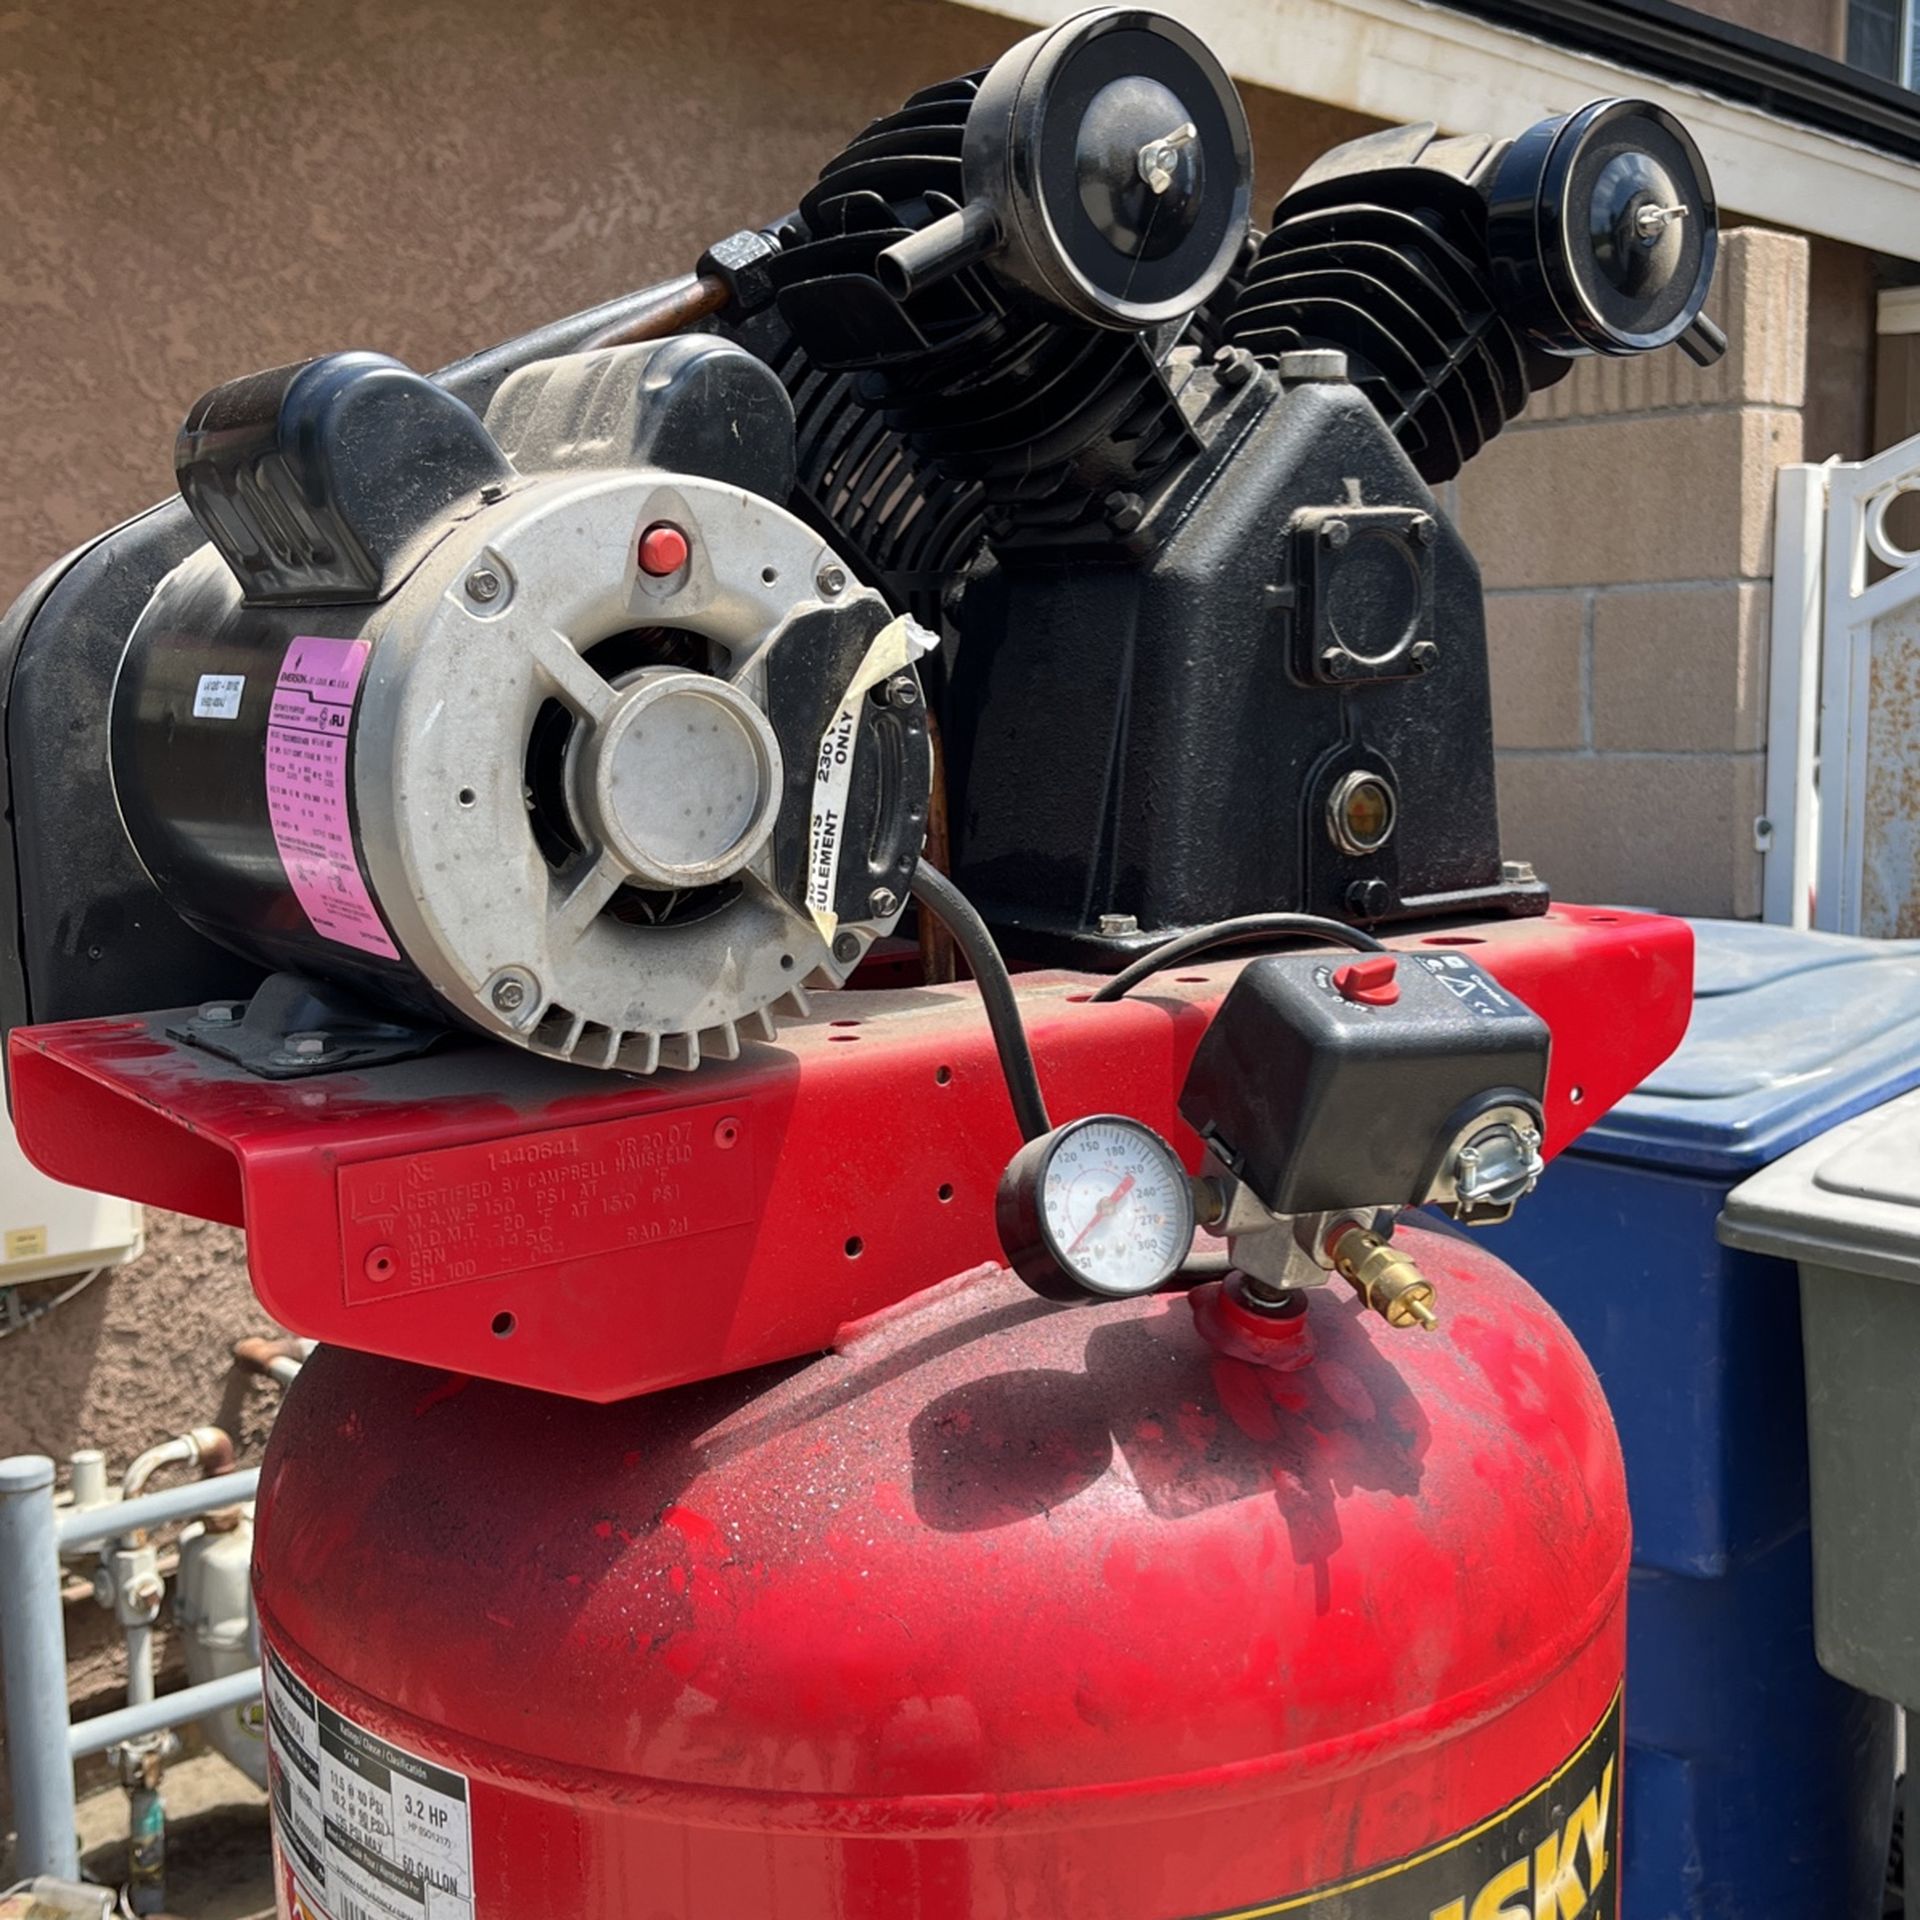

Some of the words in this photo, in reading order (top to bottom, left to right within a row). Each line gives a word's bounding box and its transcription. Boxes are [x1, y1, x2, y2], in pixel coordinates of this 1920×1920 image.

[835, 711, 853, 764] ONLY
[818, 742, 833, 783] 230
[1057, 1152, 1077, 1164] 120
[1080, 1141, 1100, 1152] 150
[1104, 1146, 1125, 1157] 180
[406, 1178, 493, 1211] CERTIFIED
[501, 1173, 521, 1194] BY
[526, 1158, 607, 1189] CAMPBELL
[1136, 1187, 1157, 1198] 240
[483, 1195, 516, 1217] 150
[534, 1186, 566, 1207] PSI
[577, 1179, 599, 1199] AT
[569, 1200, 590, 1220] AT
[601, 1191, 636, 1215] 150
[650, 1182, 680, 1205] PSI
[1138, 1239, 1158, 1250] 300
[409, 1266, 436, 1288] SH
[369, 1796, 384, 1817] PSI
[404, 1794, 425, 1821] 3.2
[429, 1804, 448, 1829] HP
[370, 1815, 385, 1836] PSI
[364, 1833, 384, 1857] MAX
[417, 1861, 458, 1897] GALLON
